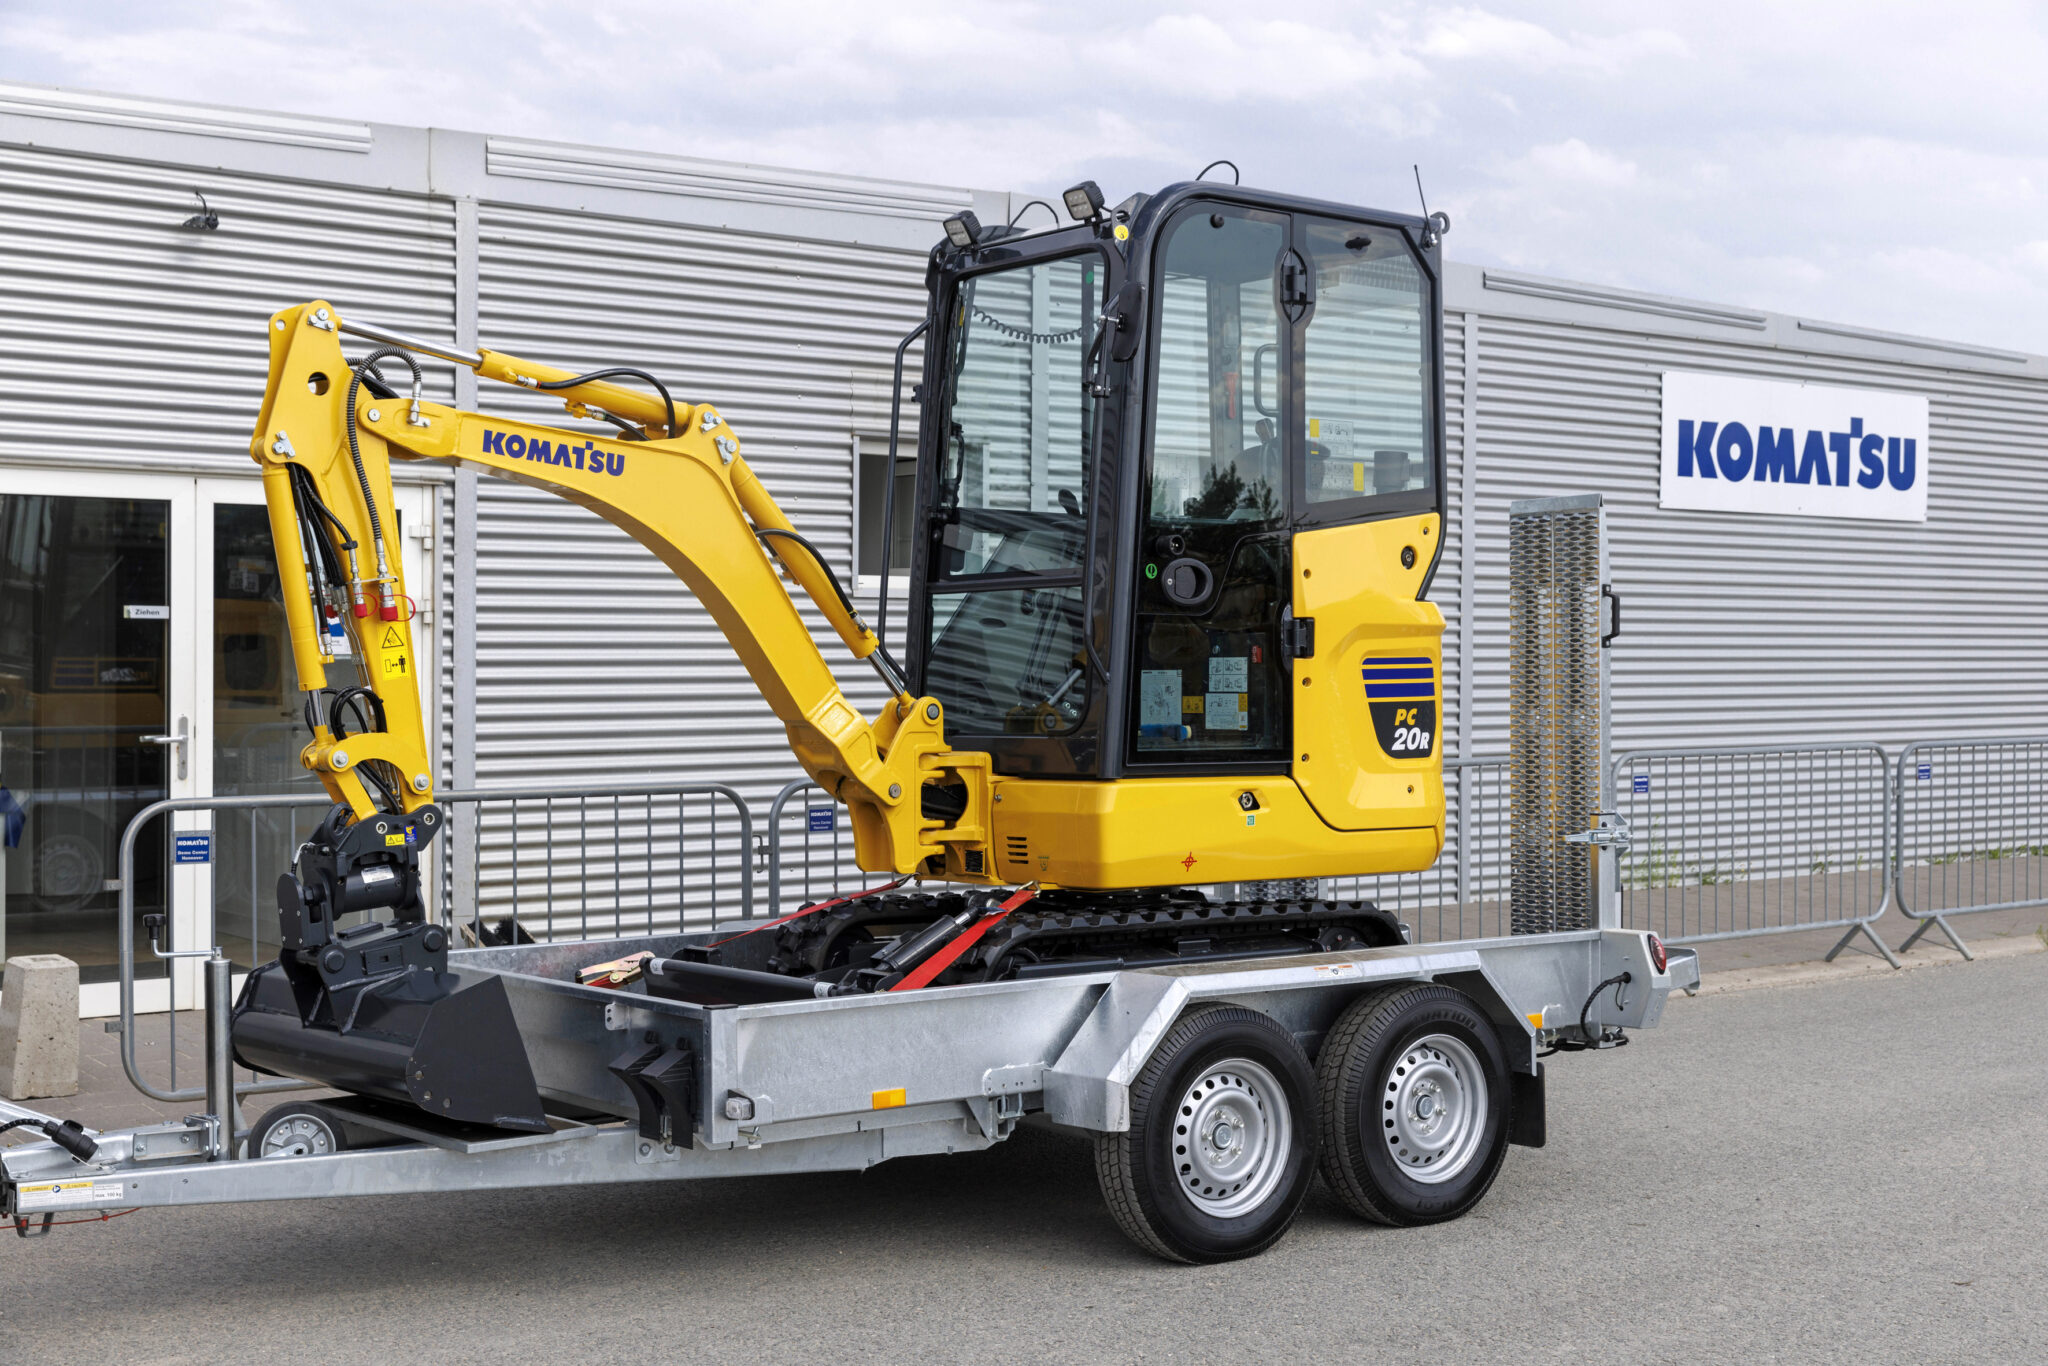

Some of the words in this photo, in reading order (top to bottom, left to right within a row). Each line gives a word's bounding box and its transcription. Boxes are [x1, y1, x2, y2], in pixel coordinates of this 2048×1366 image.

[482, 429, 626, 477] KOMATSU
[1677, 416, 1917, 491] KOMATSU
[1394, 707, 1418, 726] PC
[1391, 726, 1430, 750] 20R
[177, 838, 209, 846] KOMATSU
